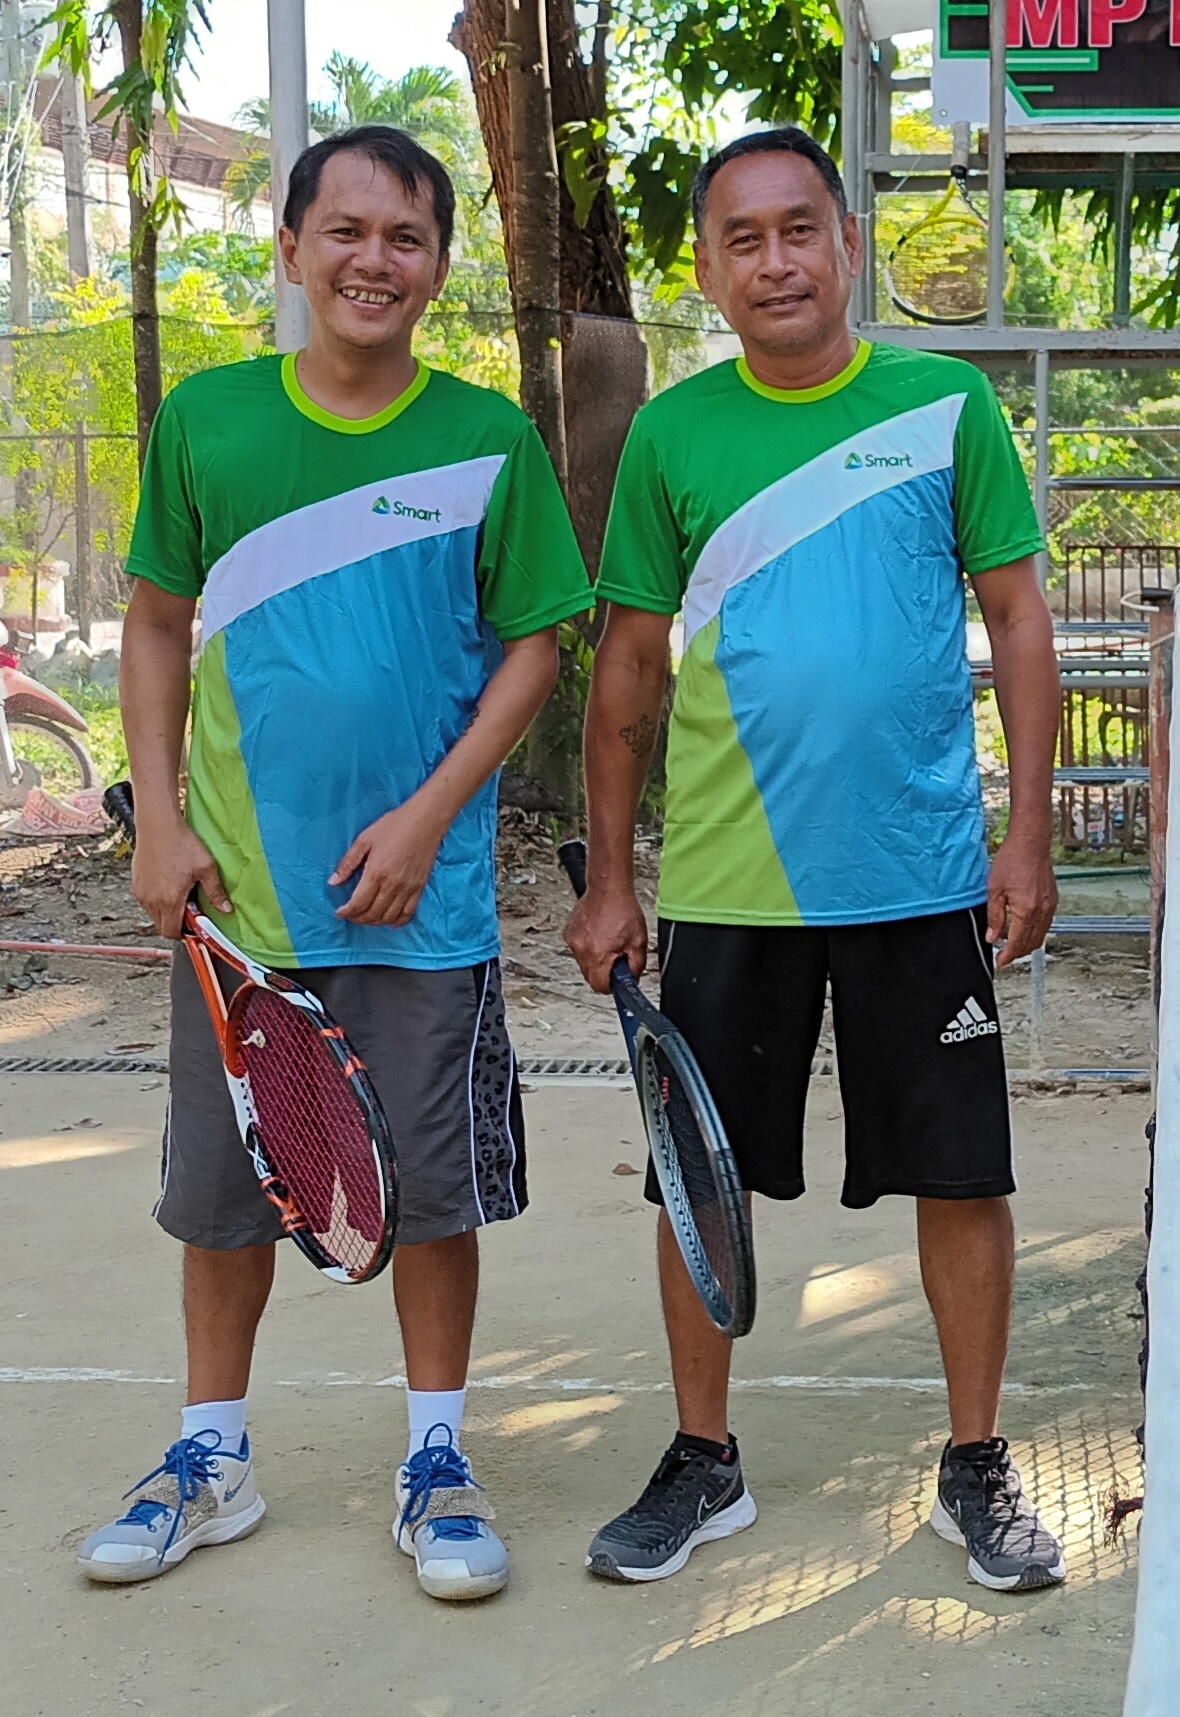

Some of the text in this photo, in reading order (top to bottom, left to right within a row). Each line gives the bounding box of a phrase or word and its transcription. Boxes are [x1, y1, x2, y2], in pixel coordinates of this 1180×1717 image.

[865, 454, 913, 468] Smart
[393, 501, 441, 523] Smart
[940, 1021, 998, 1044] adidas
